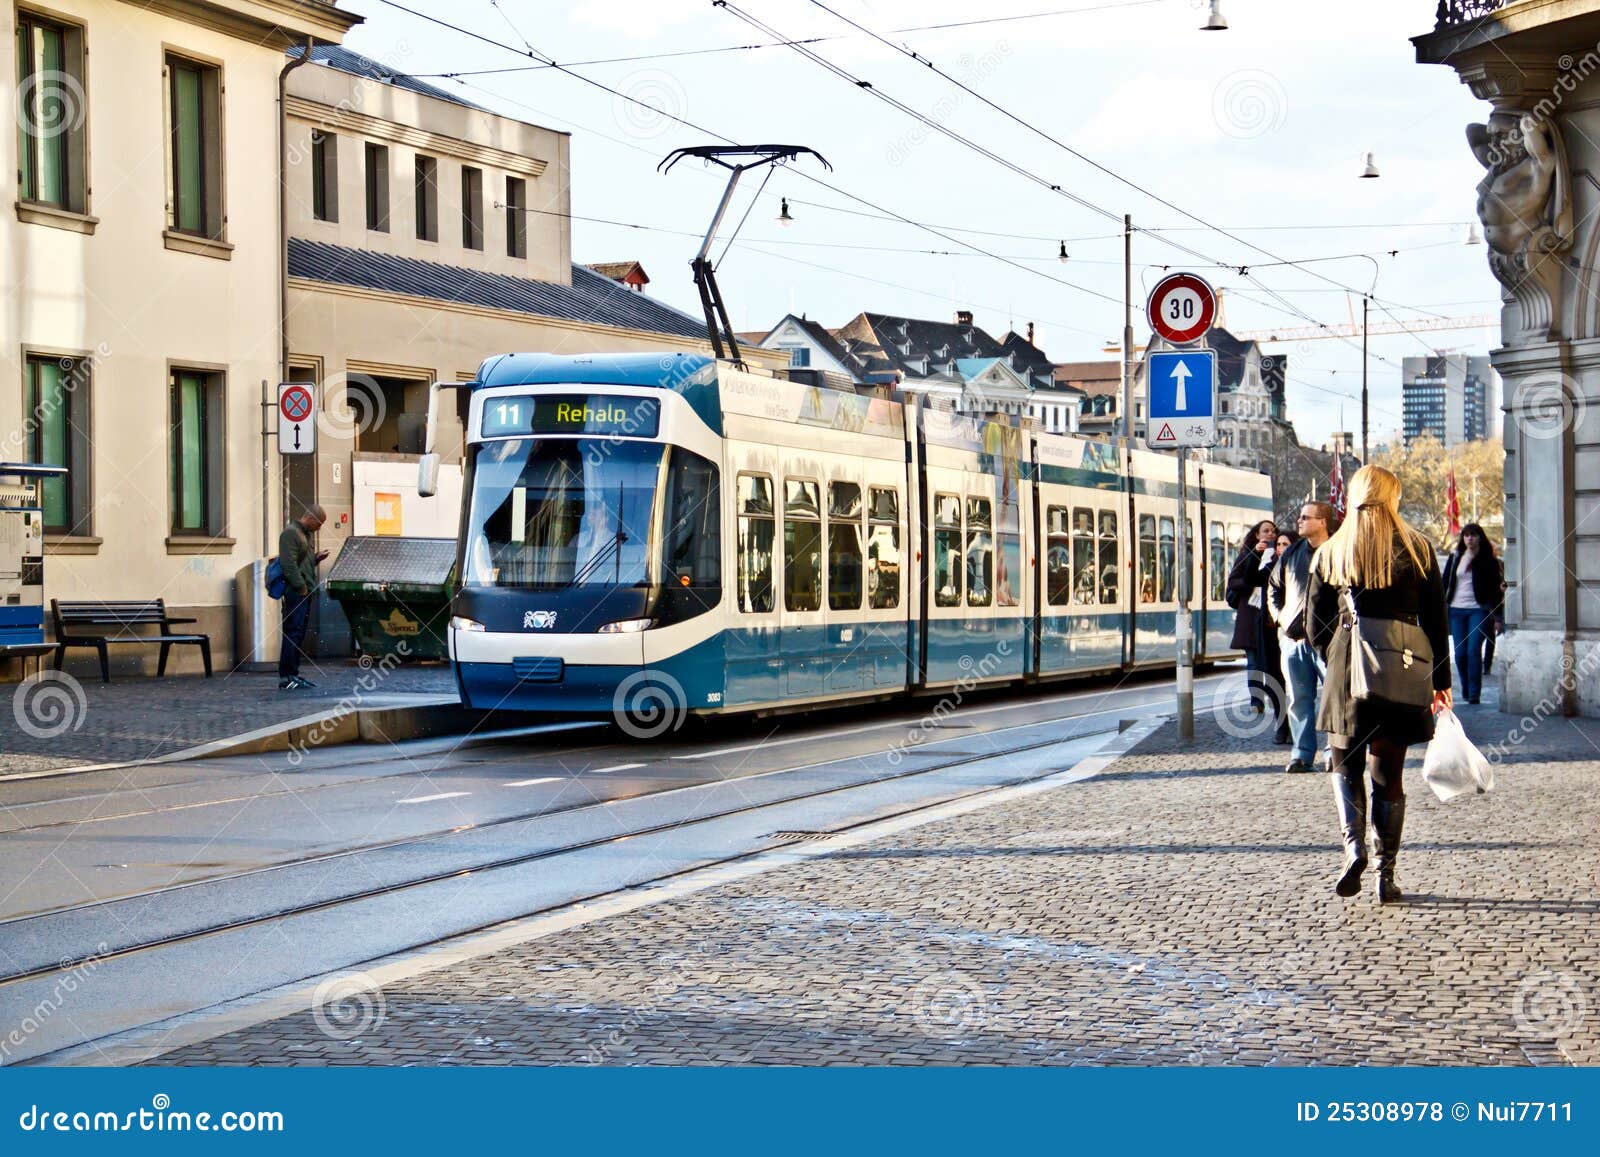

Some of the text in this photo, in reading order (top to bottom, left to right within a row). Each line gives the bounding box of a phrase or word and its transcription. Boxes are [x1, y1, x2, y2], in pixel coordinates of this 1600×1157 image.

[1170, 298, 1194, 319] 30
[497, 403, 626, 425] 11 Rehalp
